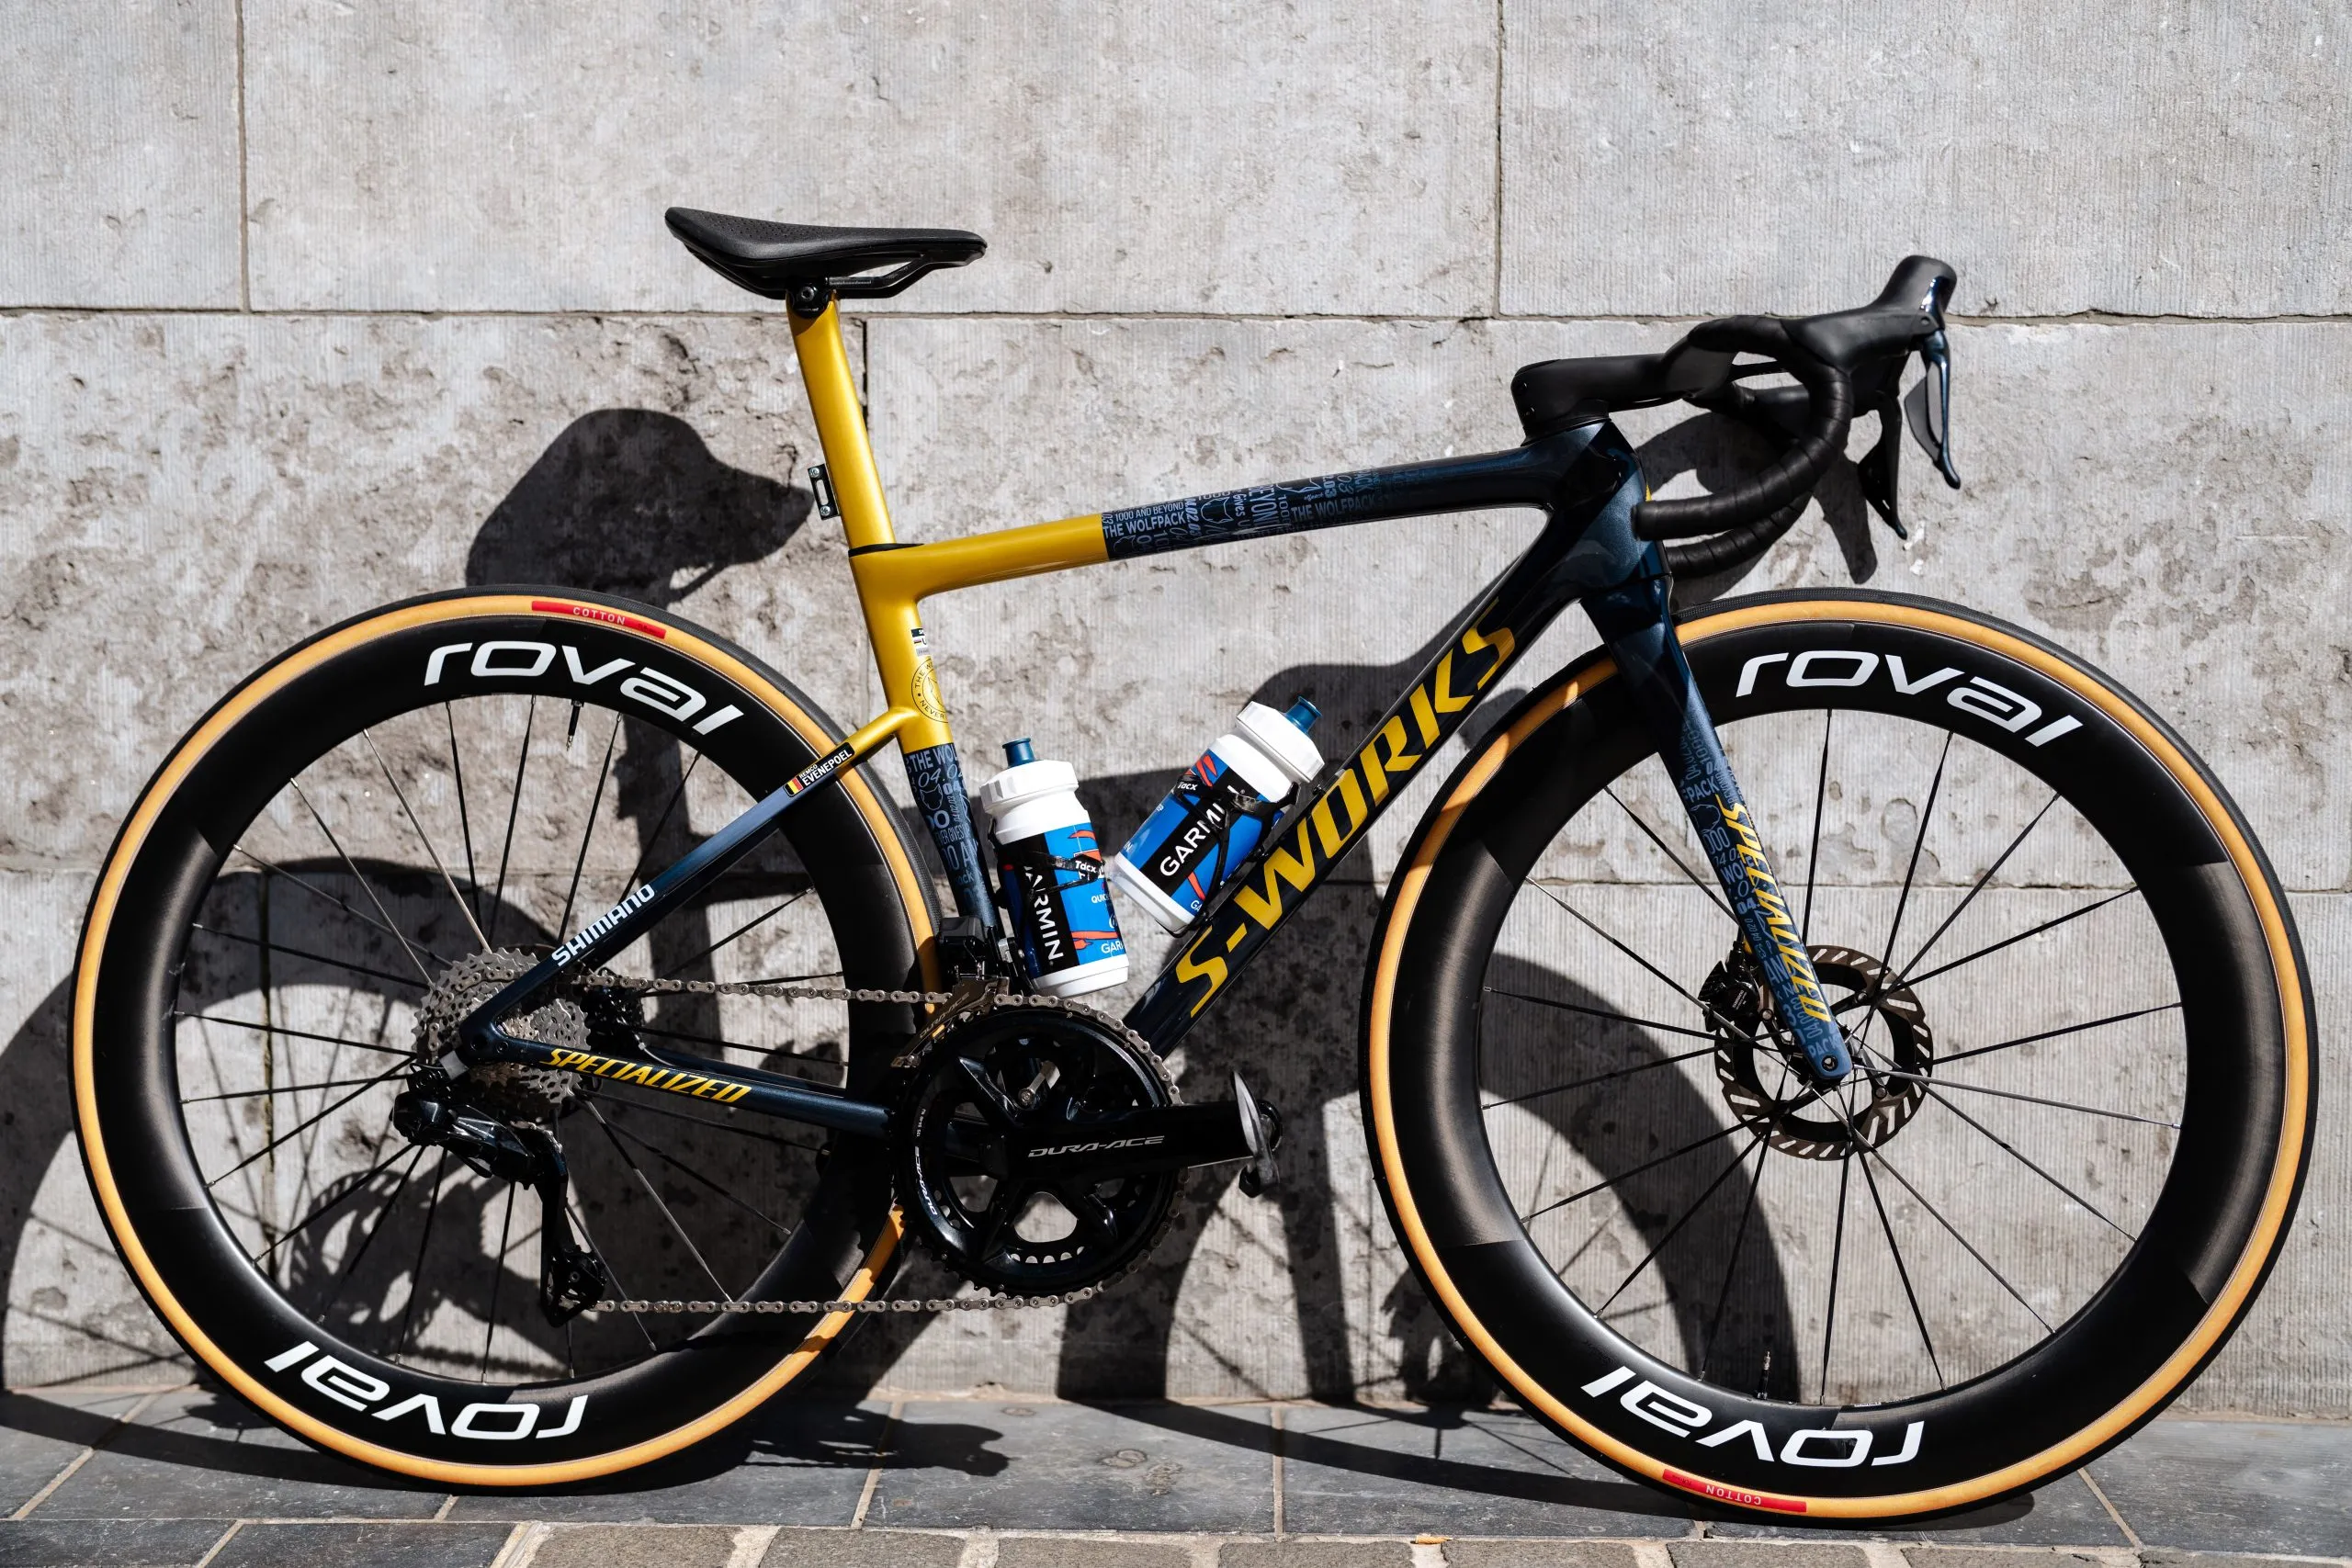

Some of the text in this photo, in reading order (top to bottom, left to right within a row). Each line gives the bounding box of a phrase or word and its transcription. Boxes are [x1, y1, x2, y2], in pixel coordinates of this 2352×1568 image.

[1136, 506, 1152, 519] AND
[1153, 502, 1184, 515] BEYOND
[1291, 504, 1313, 522] THE
[1315, 494, 1375, 519] WOLFPACK
[1103, 511, 1187, 539] THE WOLFPACK
[572, 606, 626, 626] COTTON
[424, 640, 744, 735] roval
[1736, 650, 2084, 748] roval
[798, 763, 819, 781] REMCO
[801, 749, 854, 787] EVENEPOEL
[910, 750, 933, 772] THE
[1177, 781, 1199, 792] Tacx
[1175, 597, 1516, 1018] S-WORKS
[1075, 860, 1097, 874] Tacx
[1023, 865, 1065, 961] ARMIN
[1714, 794, 1831, 1022] SPECIALIZED
[551, 884, 655, 966] SHIMANO
[540, 1048, 752, 1103] SPECIALIZED
[1027, 1134, 1165, 1158] DURA-ACE
[264, 1340, 589, 1440] roval
[1580, 1365, 1925, 1467] roval
[1705, 1483, 1762, 1506] COTTON
